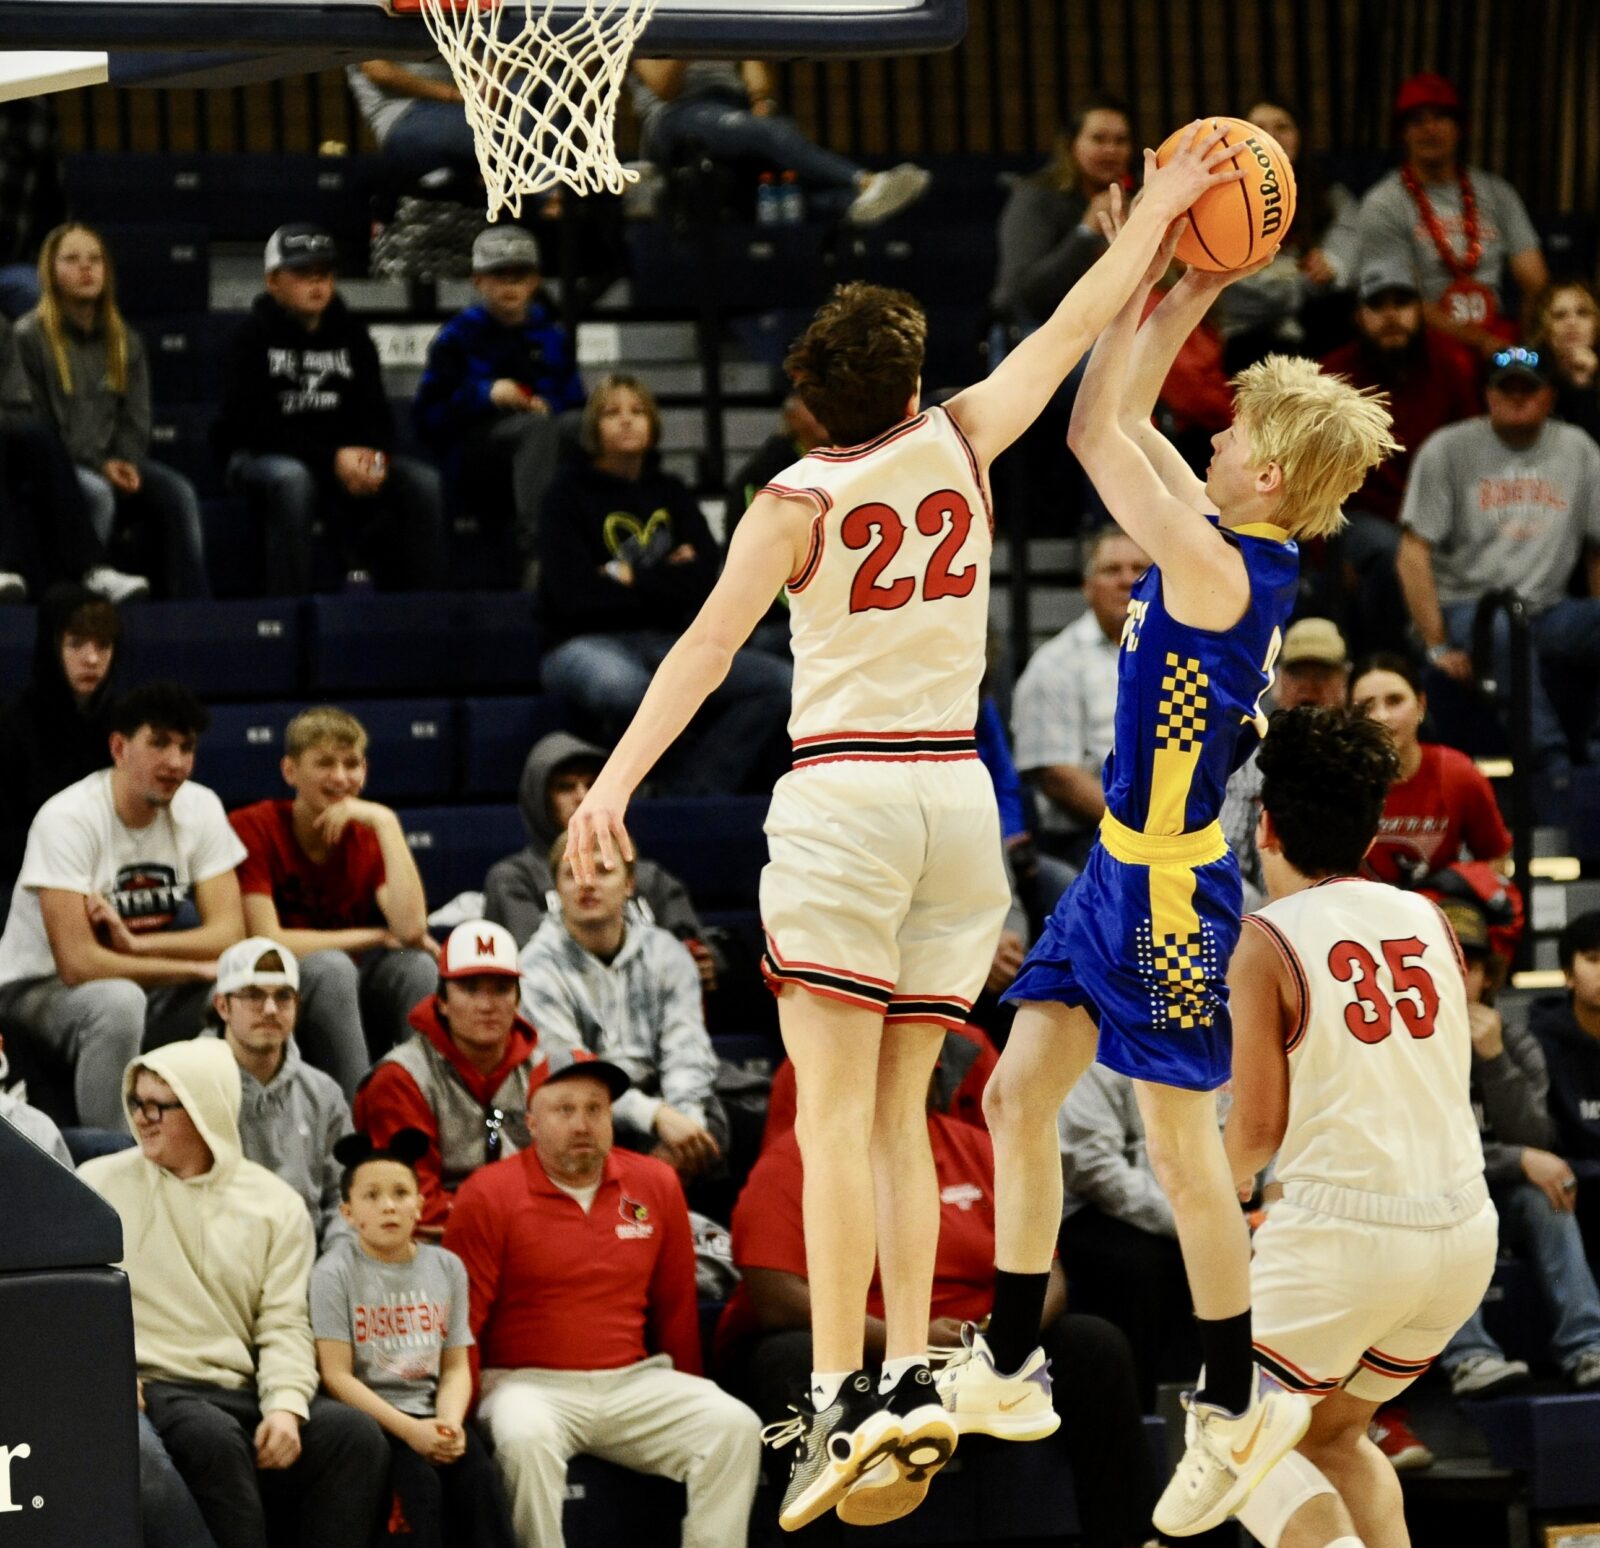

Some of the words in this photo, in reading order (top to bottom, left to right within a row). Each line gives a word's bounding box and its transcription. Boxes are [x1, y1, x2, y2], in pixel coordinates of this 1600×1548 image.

[1246, 138, 1282, 238] Wilson
[840, 488, 977, 615] 22
[476, 935, 495, 957] M
[1327, 935, 1440, 1045] 35
